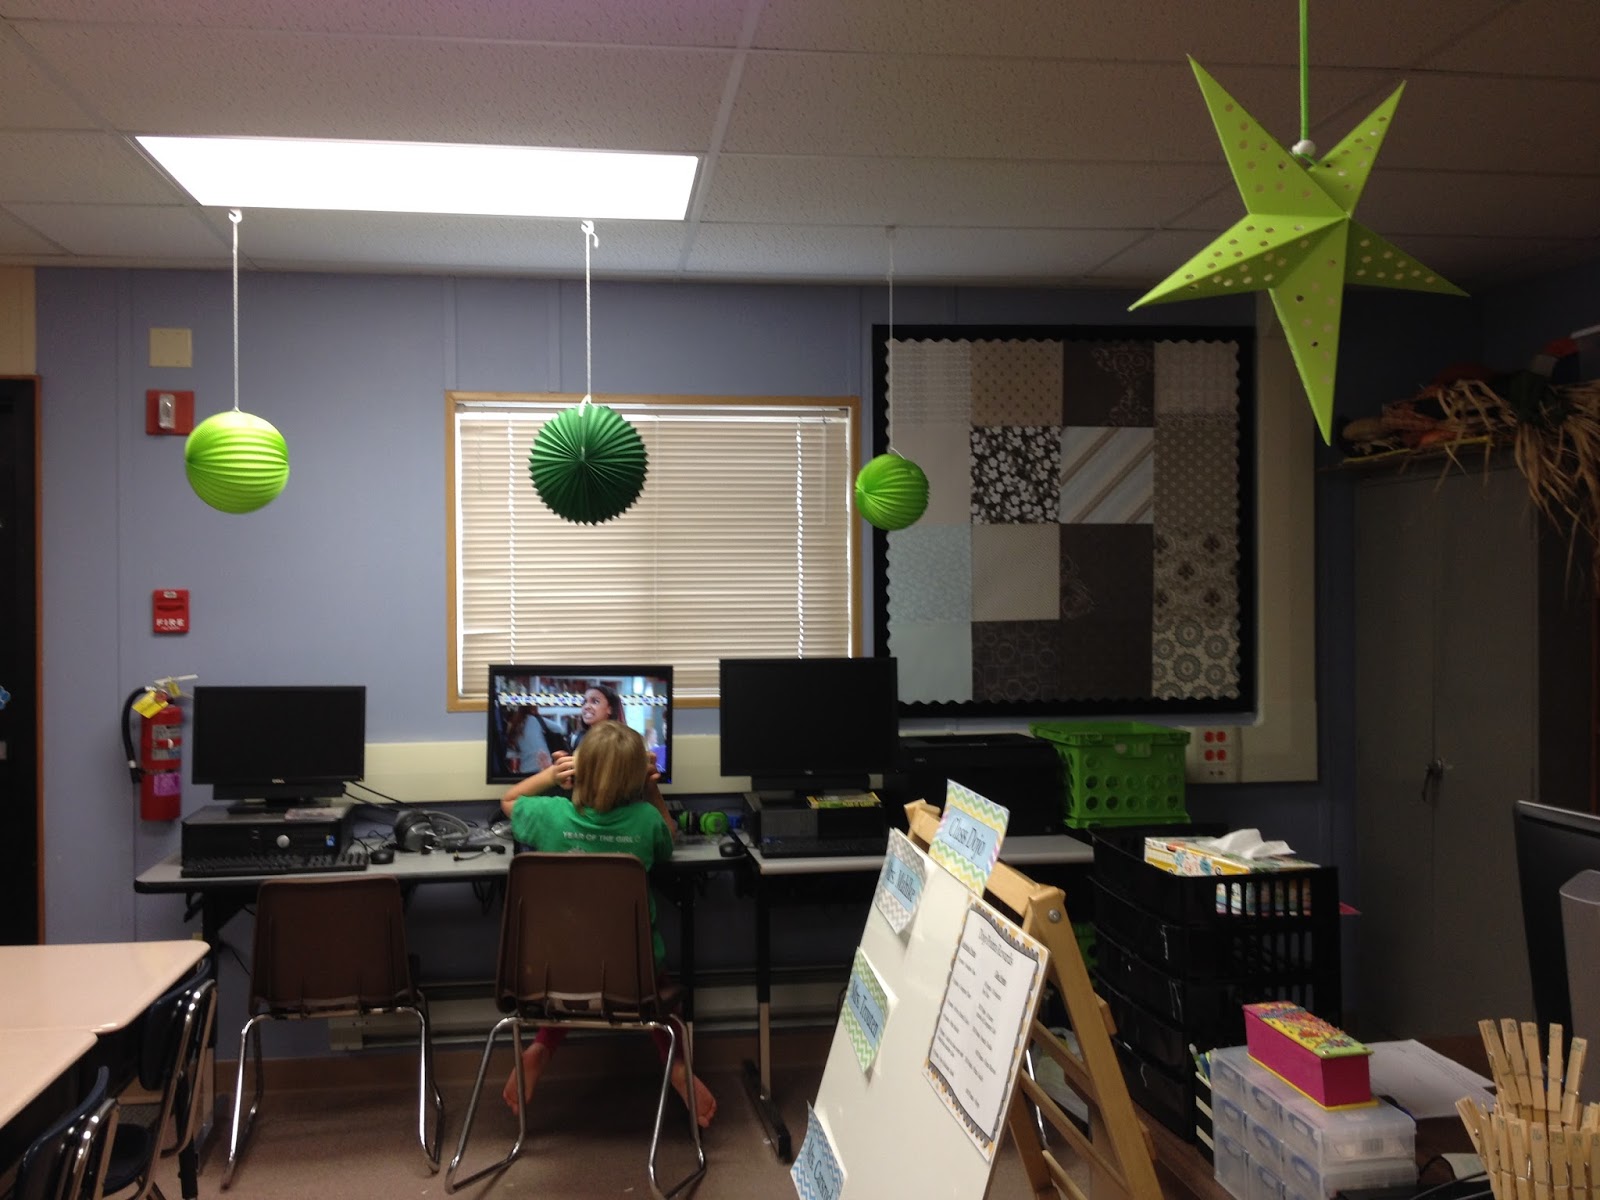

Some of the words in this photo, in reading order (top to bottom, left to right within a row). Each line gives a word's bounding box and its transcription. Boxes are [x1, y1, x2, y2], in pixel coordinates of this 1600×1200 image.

[156, 618, 185, 627] FIRE
[563, 831, 585, 839] YEAR
[586, 833, 597, 841] OF
[599, 834, 614, 842] THE
[615, 835, 634, 843] GIRL
[948, 817, 969, 845] Class
[967, 827, 986, 860] Dojo
